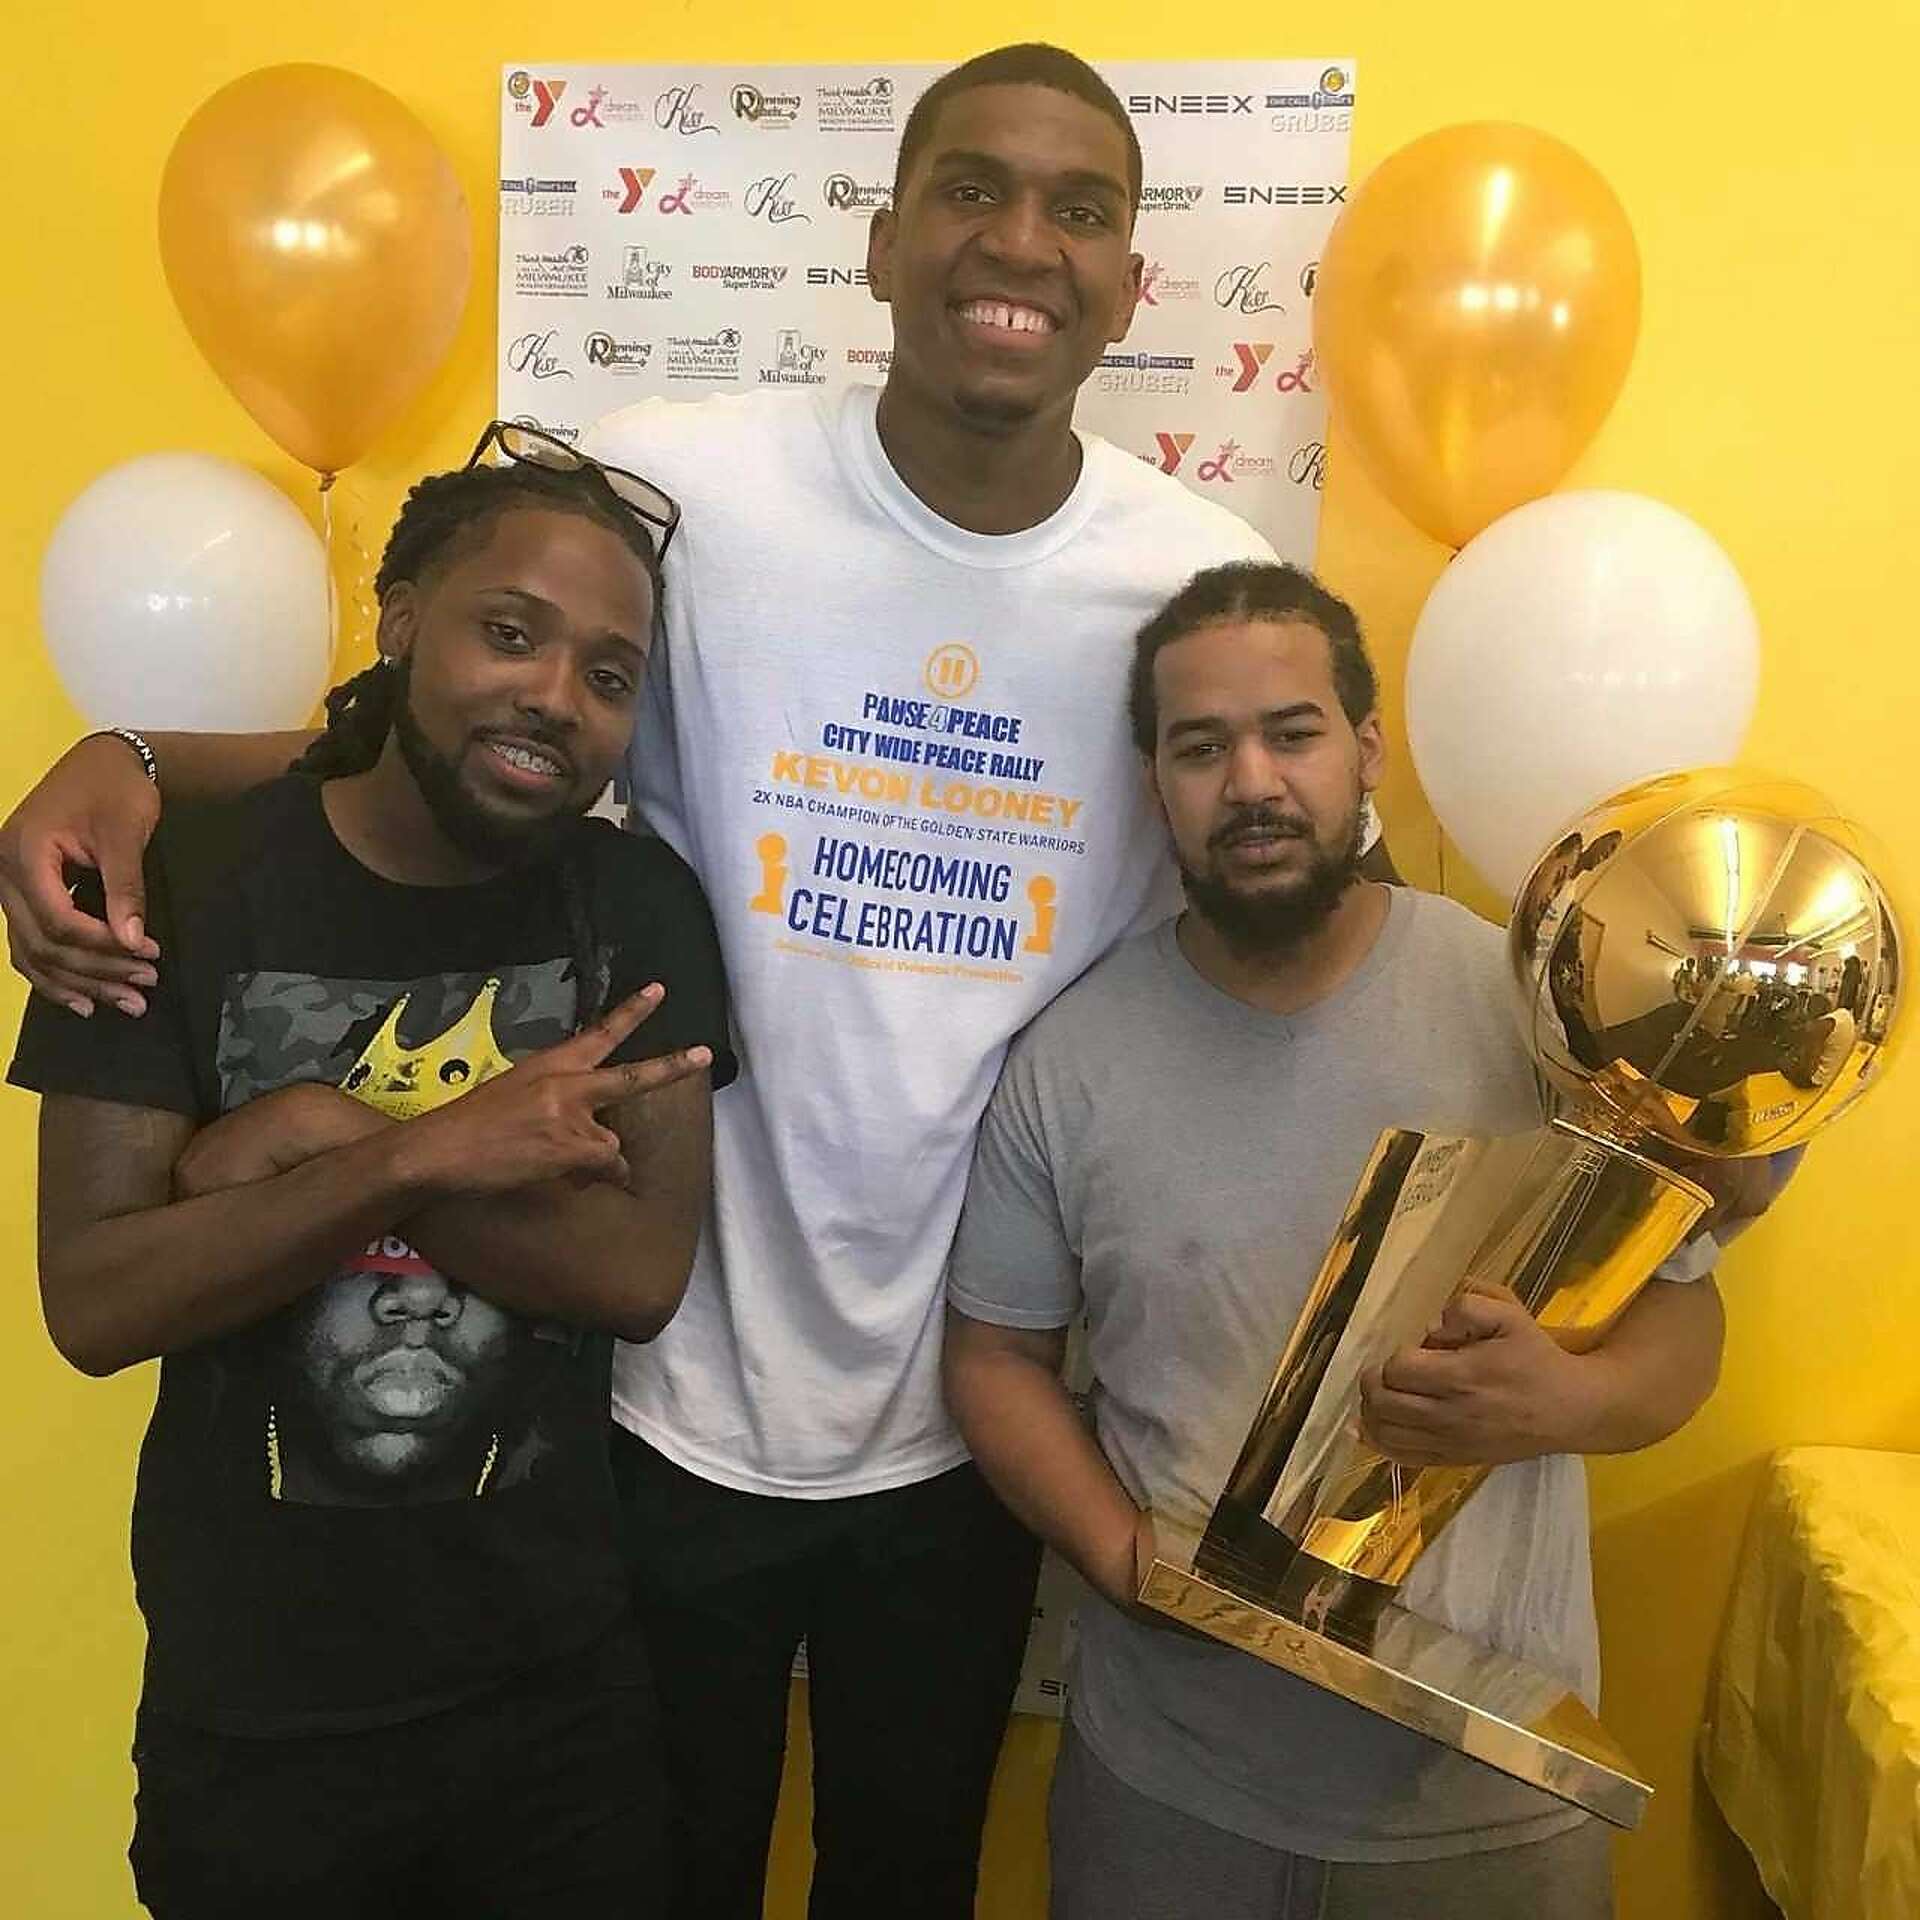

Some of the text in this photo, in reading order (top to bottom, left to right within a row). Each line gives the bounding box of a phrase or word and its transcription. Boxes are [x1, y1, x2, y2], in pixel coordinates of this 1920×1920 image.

[1128, 96, 1253, 114] SNEEX
[1140, 187, 1184, 201] ARMOR
[1223, 186, 1347, 204] SNEEX
[647, 262, 672, 278] City
[692, 266, 768, 280] BODYARMOR
[806, 269, 868, 285] SNE
[646, 274, 660, 286] of
[606, 286, 672, 300] Milwaukee
[801, 346, 827, 362] City
[799, 359, 812, 371] of
[1215, 366, 1234, 377] the
[758, 370, 826, 384] Milwaukee
[823, 722, 1045, 782] CITY WIDE PEACE RALLY
[771, 750, 1083, 829] KEVON LOONEY
[752, 789, 1086, 855] 2X NBA CHAMPION OF THE GOLDEN STATE WARRIORS
[812, 835, 1012, 903] HOMECOMING
[787, 888, 1018, 961] CELEBRATION
